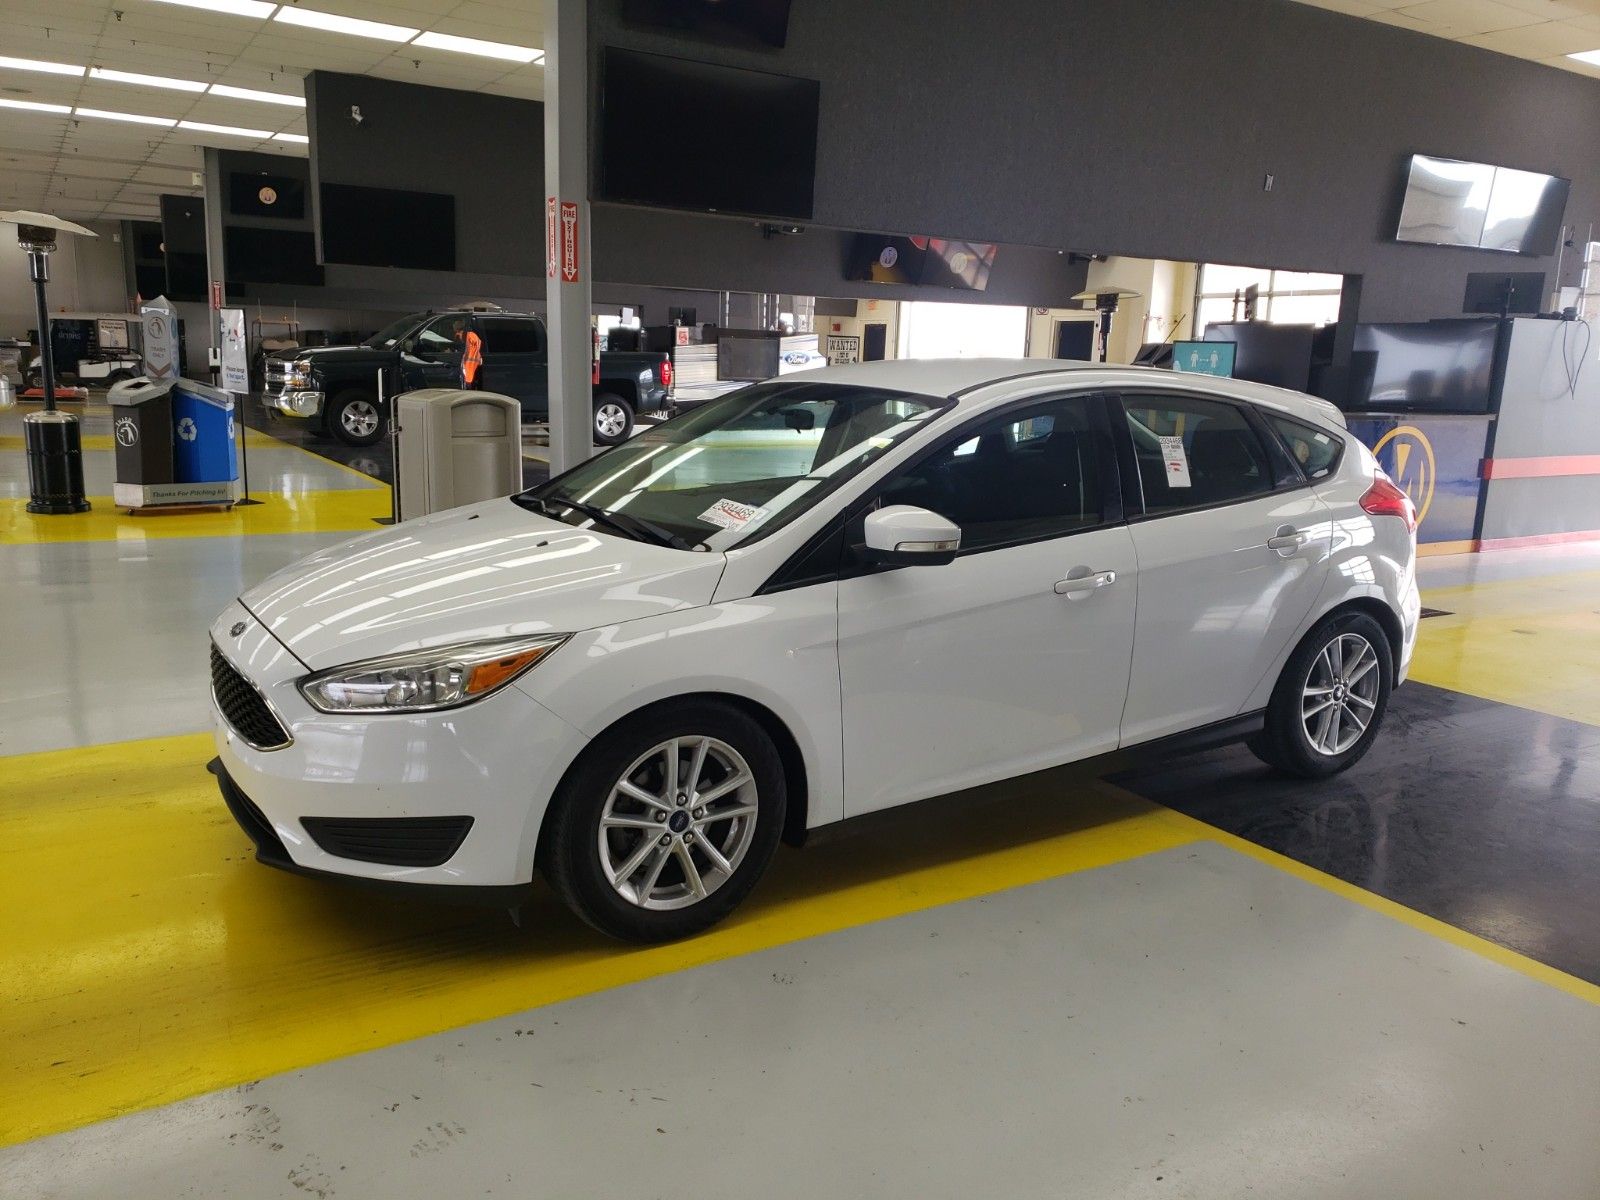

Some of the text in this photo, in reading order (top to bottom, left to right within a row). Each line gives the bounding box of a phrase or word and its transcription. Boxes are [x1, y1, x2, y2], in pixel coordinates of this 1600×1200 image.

[563, 209, 576, 218] FIRE
[829, 339, 857, 351] WANTED
[787, 353, 807, 364] Ford
[189, 489, 216, 497] Pitching
